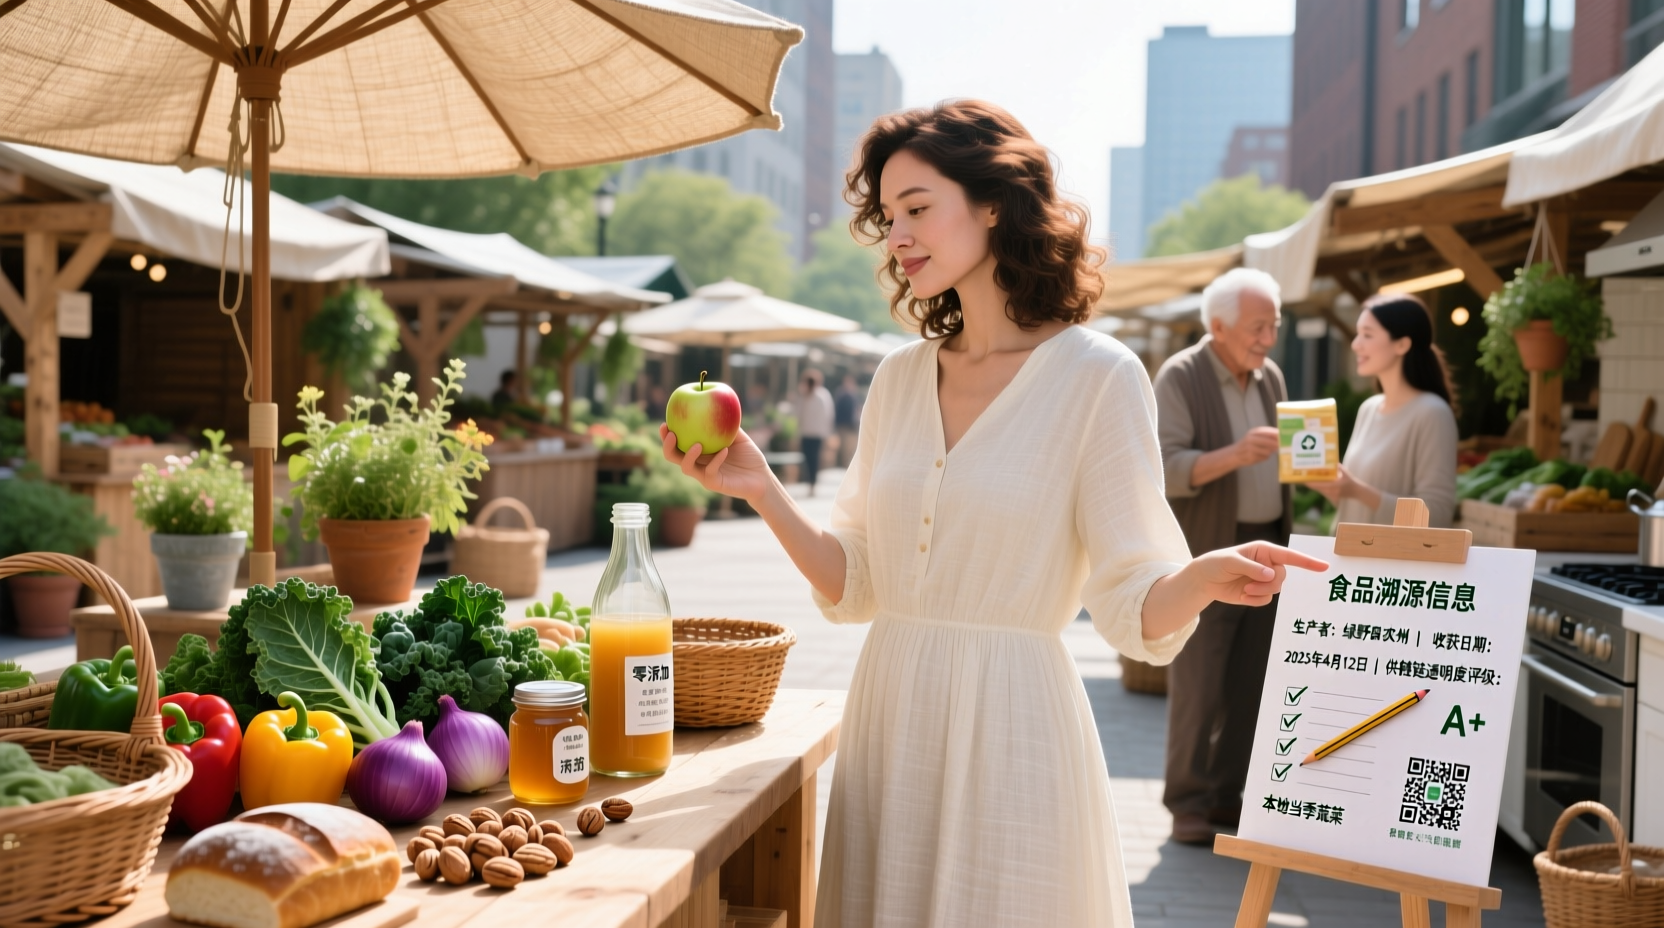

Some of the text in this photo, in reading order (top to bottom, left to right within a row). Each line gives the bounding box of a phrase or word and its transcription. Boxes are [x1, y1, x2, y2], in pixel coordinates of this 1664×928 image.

[1328, 573, 1476, 612] 食品溯源信息
[1284, 650, 1368, 672] 2025年4月12日
[1440, 704, 1486, 738] A+
